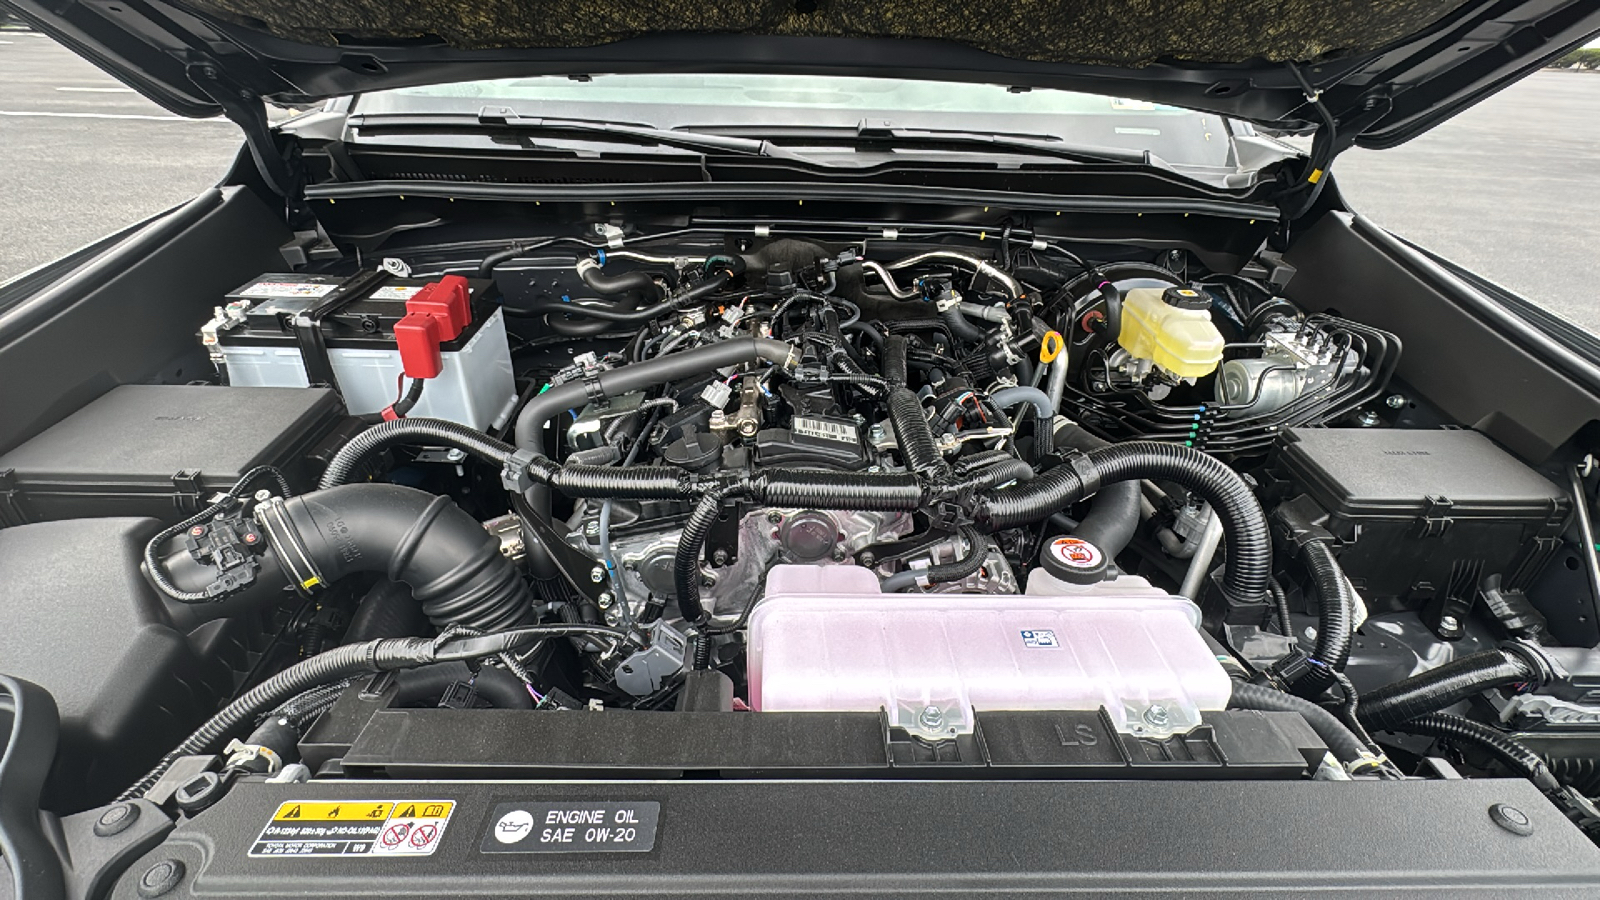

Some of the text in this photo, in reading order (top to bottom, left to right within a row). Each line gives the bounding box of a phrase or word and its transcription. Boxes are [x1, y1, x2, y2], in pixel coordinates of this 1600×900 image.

[1054, 724, 1098, 746] LS
[545, 809, 639, 824] ENGINE OIL
[540, 828, 636, 843] SAE 0W-20
